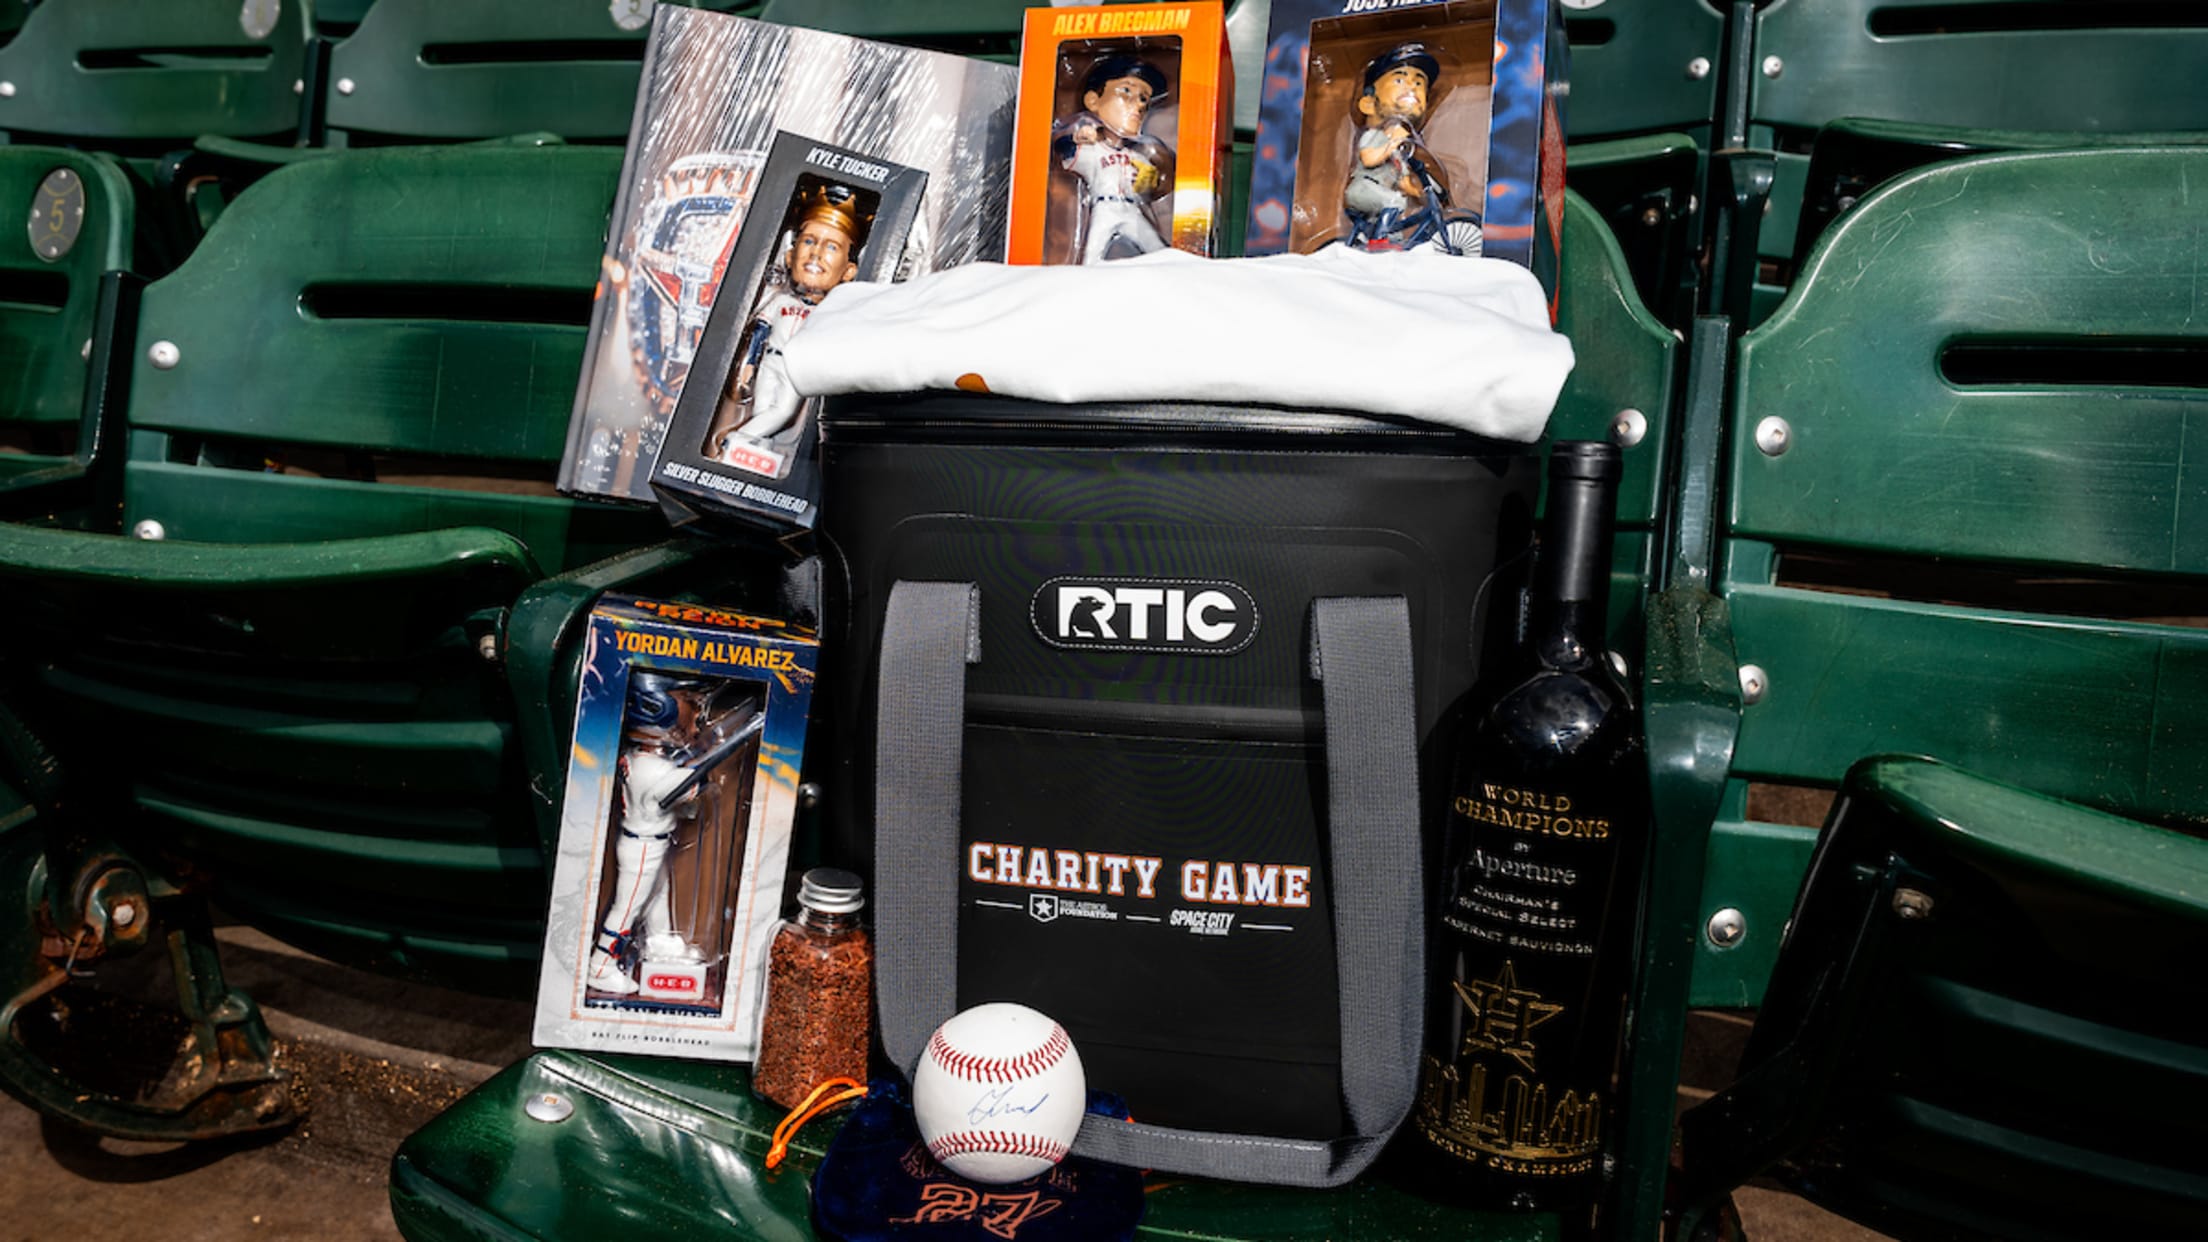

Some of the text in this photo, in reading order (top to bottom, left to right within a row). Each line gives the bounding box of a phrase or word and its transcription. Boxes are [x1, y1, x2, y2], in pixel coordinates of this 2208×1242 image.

[1052, 9, 1191, 35] ALEX BREGMAN
[805, 147, 890, 182] KYLE TUCKER
[49, 199, 65, 232] 5
[662, 462, 808, 513] SILVER SLUGGER BOBBLEHEAD
[1058, 586, 1237, 642] RTIC
[615, 630, 795, 671] YORDAN ALVAREZ
[1484, 783, 1572, 812] WORLD
[1455, 797, 1609, 838] CHAMPIONS
[968, 841, 1312, 908] CHARITY GAME
[1469, 849, 1577, 885] Aperture
[1060, 908, 1117, 920] FOUNDATION
[1459, 896, 1577, 928] SPECIAL SELECT
[1473, 884, 1560, 911] CHAIRMAN'S
[1170, 909, 1235, 929] SPACE CITY
[1510, 936, 1593, 954] SAUVIGNON
[914, 1183, 1040, 1240] 27
